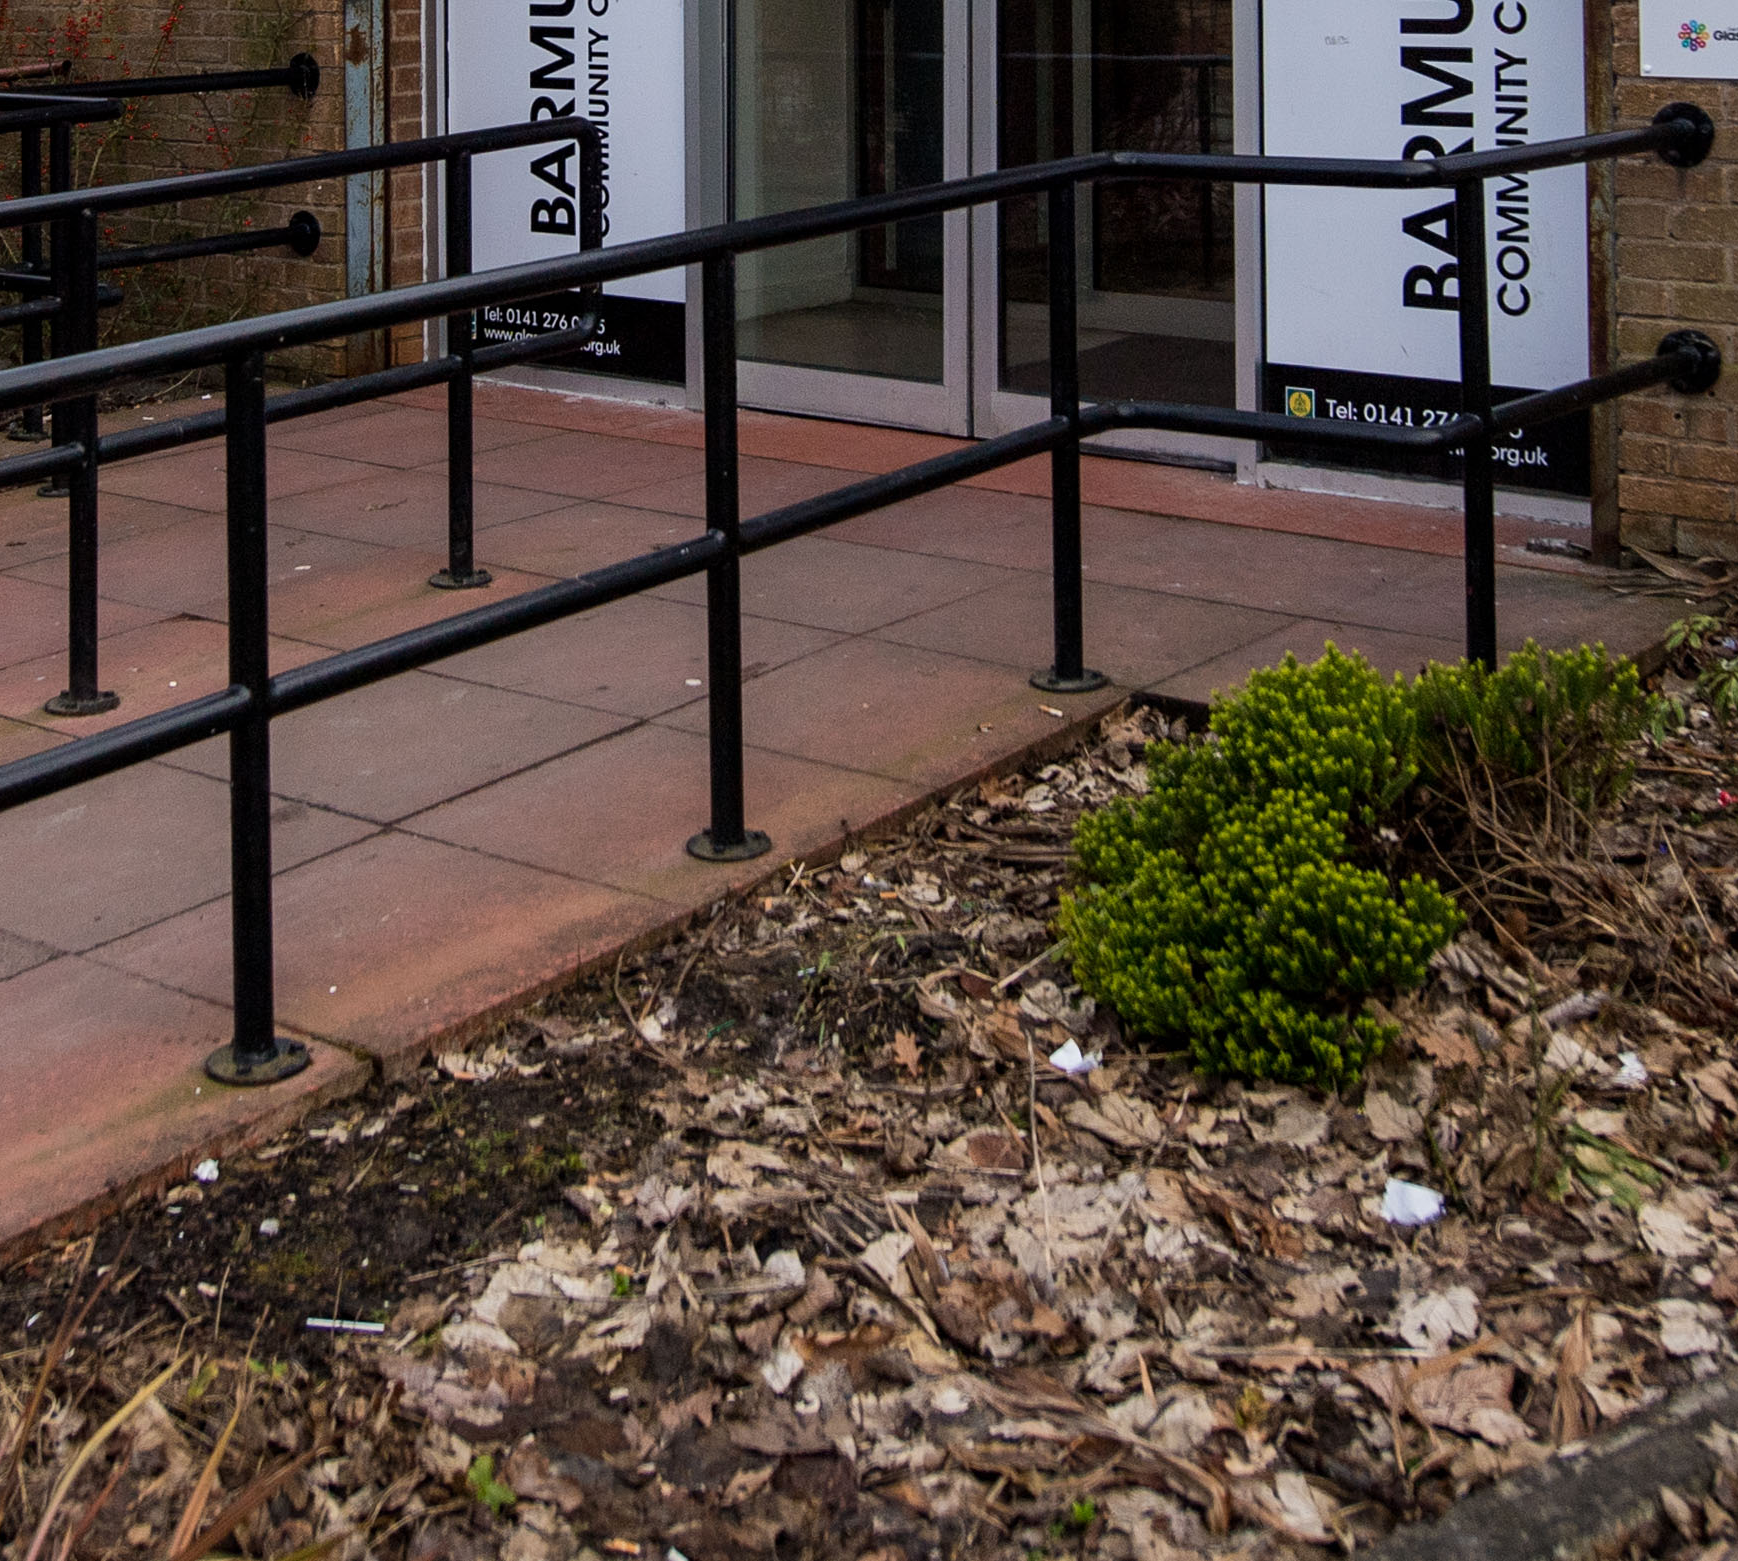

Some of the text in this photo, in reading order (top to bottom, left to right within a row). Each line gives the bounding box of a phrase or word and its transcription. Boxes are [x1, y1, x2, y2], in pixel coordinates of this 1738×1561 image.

[484, 306, 503, 322] Tel:
[506, 308, 538, 326] 0141
[543, 312, 568, 329] 276
[1326, 398, 1358, 421] Tel:
[1364, 403, 1414, 427] 0141
